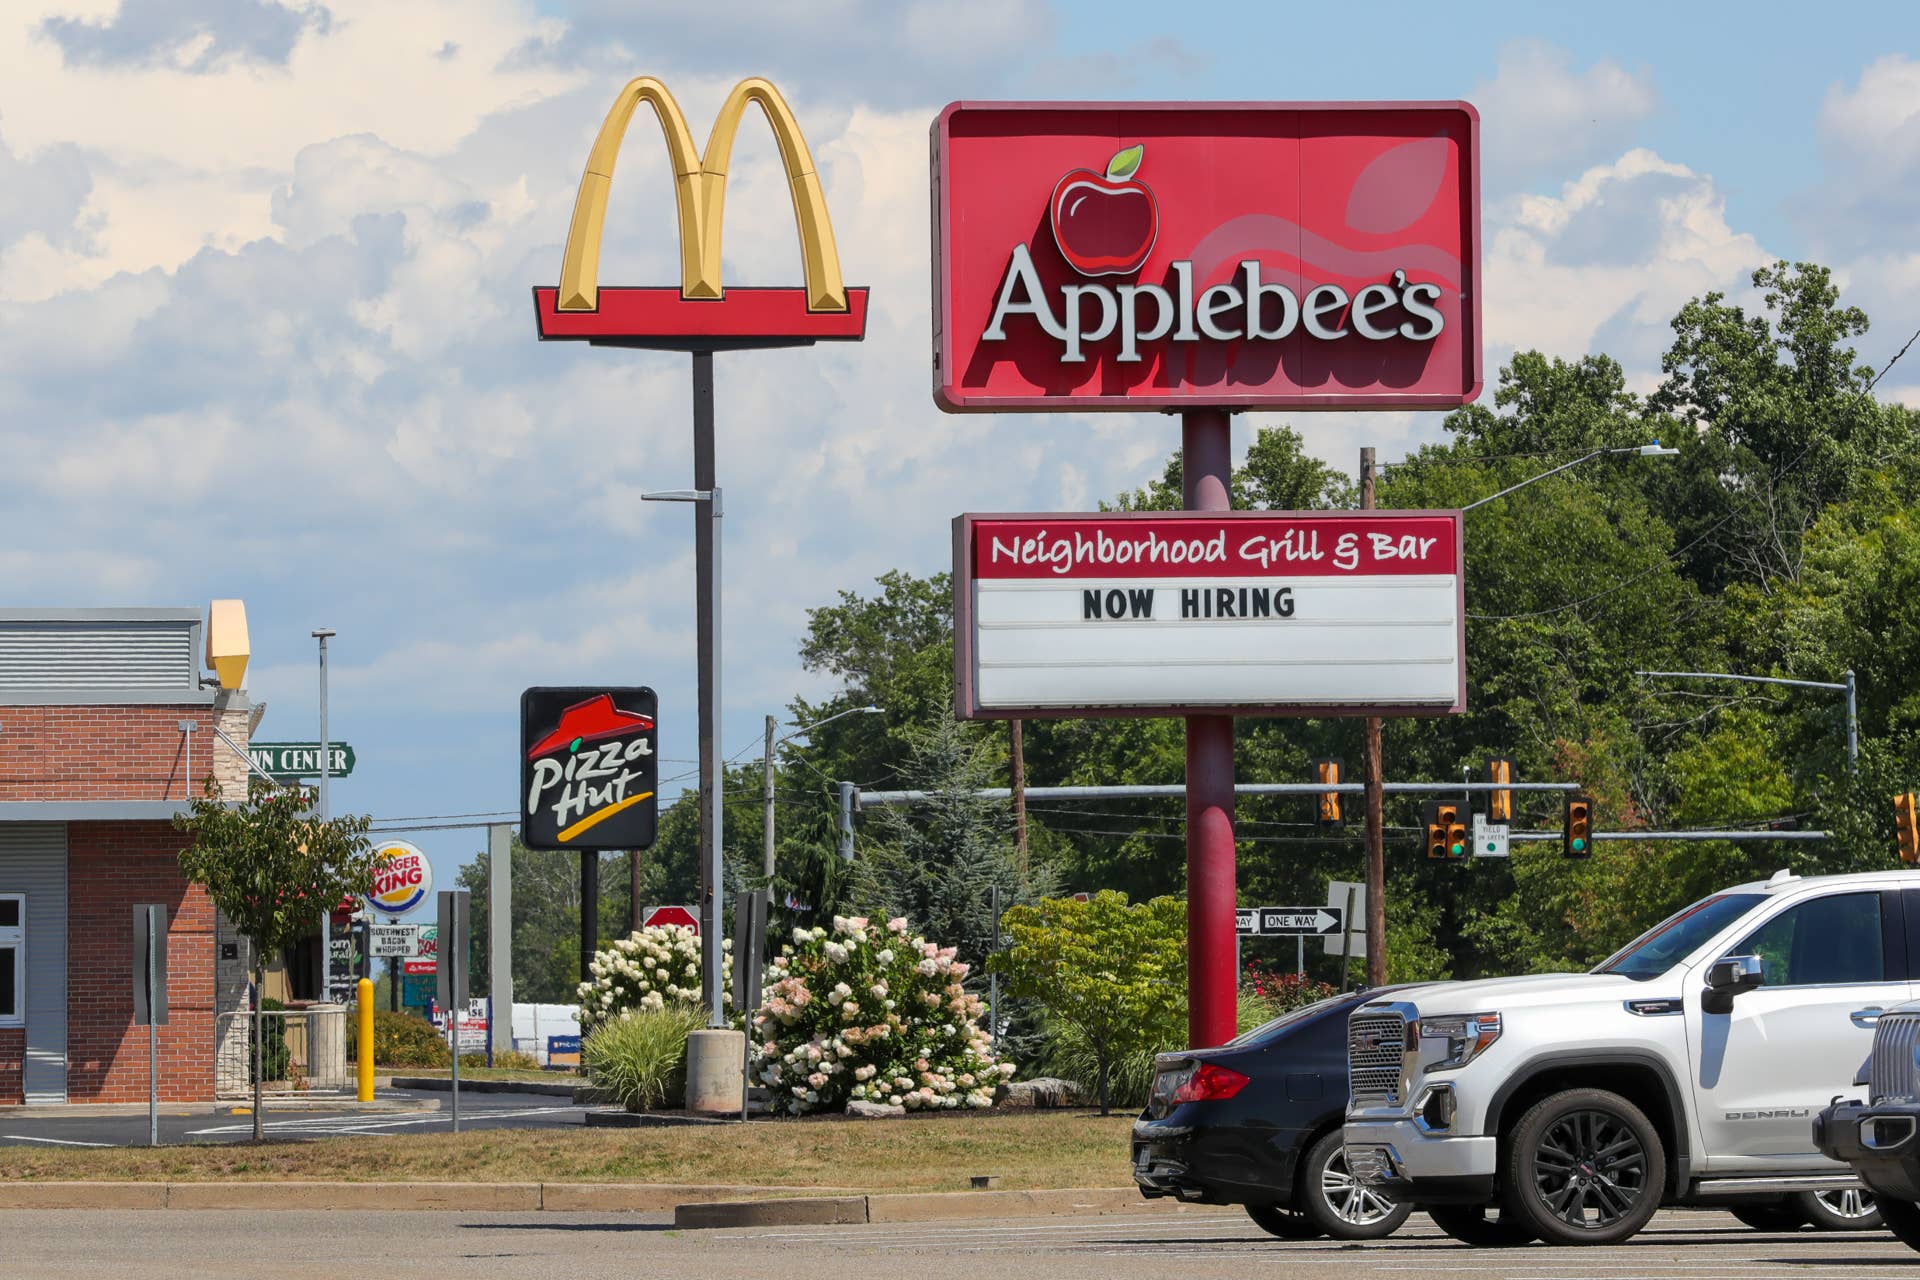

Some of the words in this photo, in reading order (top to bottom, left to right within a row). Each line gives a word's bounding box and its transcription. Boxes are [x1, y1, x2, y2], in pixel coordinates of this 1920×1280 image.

[981, 241, 1445, 364] Applebee's
[991, 529, 1227, 574] Neighborhood
[1238, 528, 1324, 569] Grill
[1332, 533, 1360, 570] &
[1366, 532, 1437, 560] Bar
[1083, 588, 1154, 619] NOW
[1181, 587, 1295, 618] HIRING
[281, 749, 347, 770] CENTER
[528, 738, 653, 815] Pizza
[551, 768, 643, 827] Hut
[369, 855, 420, 877] URGER
[370, 867, 423, 898] KING
[1236, 918, 1251, 926] AY
[1267, 916, 1290, 926] ONE
[1294, 916, 1317, 926] WAY
[370, 928, 416, 937] SOUTHWEST
[381, 937, 406, 945] BACON
[1725, 1109, 1809, 1121] DENALI
